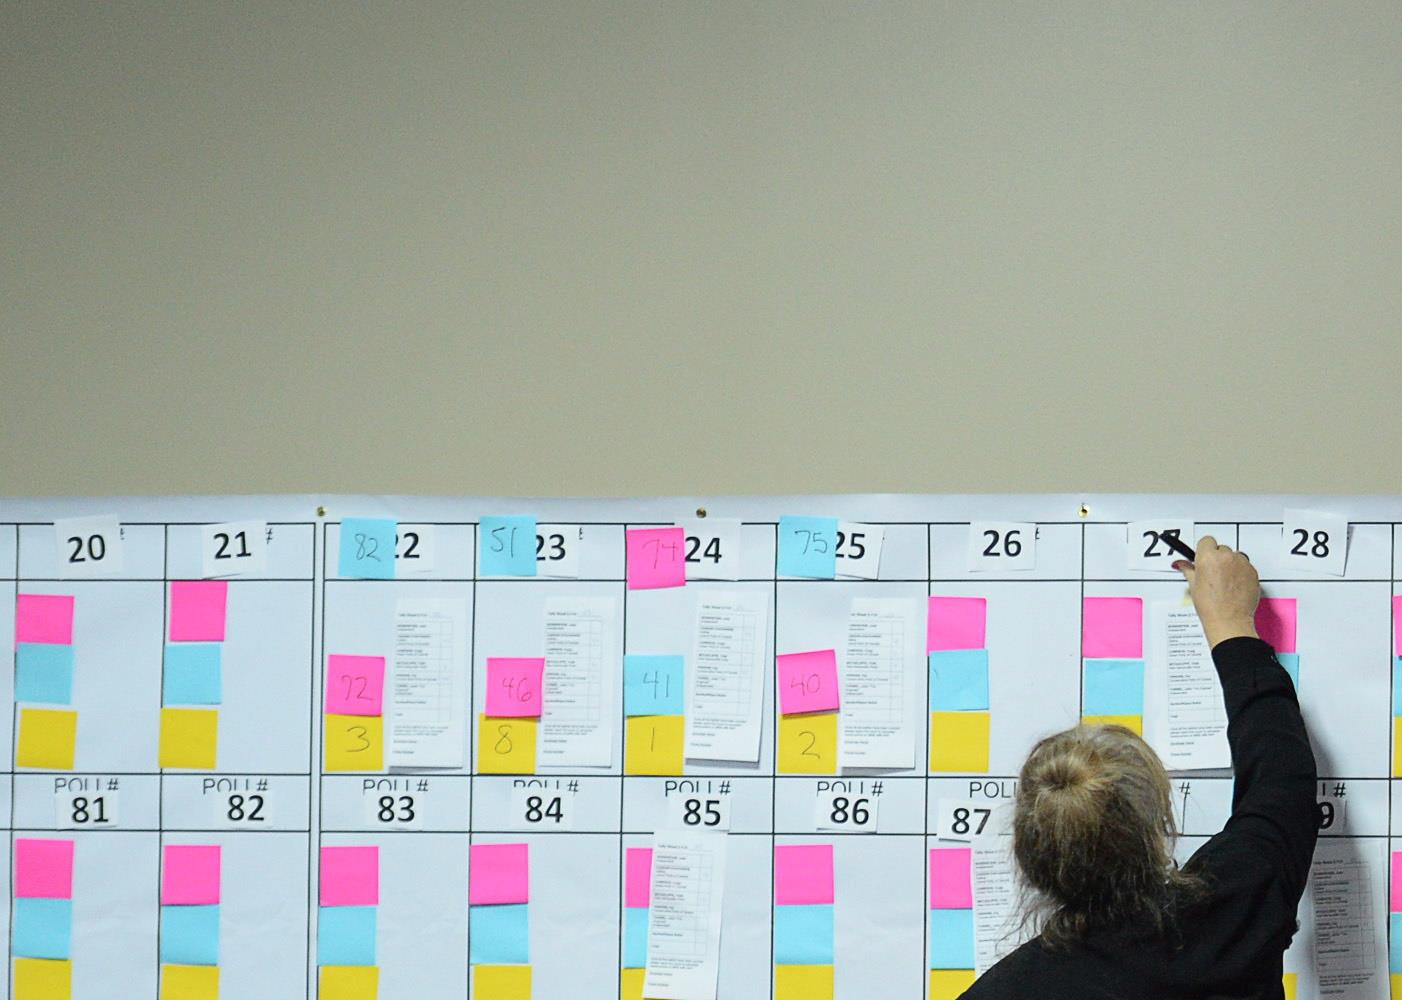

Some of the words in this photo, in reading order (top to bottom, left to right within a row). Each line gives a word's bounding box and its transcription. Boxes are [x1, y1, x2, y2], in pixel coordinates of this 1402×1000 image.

[66, 533, 107, 564] 20
[212, 531, 252, 560] 21
[353, 532, 382, 563] 82
[394, 532, 421, 559] 2
[489, 526, 518, 559] 51
[535, 534, 567, 561] 23
[684, 536, 723, 564] 24
[794, 529, 829, 556] 75
[835, 531, 867, 560] 25
[981, 528, 1023, 558] 26
[1289, 528, 1331, 559] 28
[339, 674, 376, 702] 72
[501, 676, 534, 703] 46
[642, 669, 671, 700] 41
[790, 673, 823, 697] 40
[345, 725, 371, 753] 3
[494, 723, 514, 756] 8
[649, 726, 656, 753] 1
[797, 731, 822, 760] 2
[71, 796, 110, 824] 81
[226, 794, 266, 822] 82
[377, 795, 416, 823] 83
[525, 796, 564, 823] 84
[682, 798, 722, 827] 85
[829, 796, 870, 825] 86
[951, 807, 992, 836] 87
[1317, 801, 1335, 829] 9
